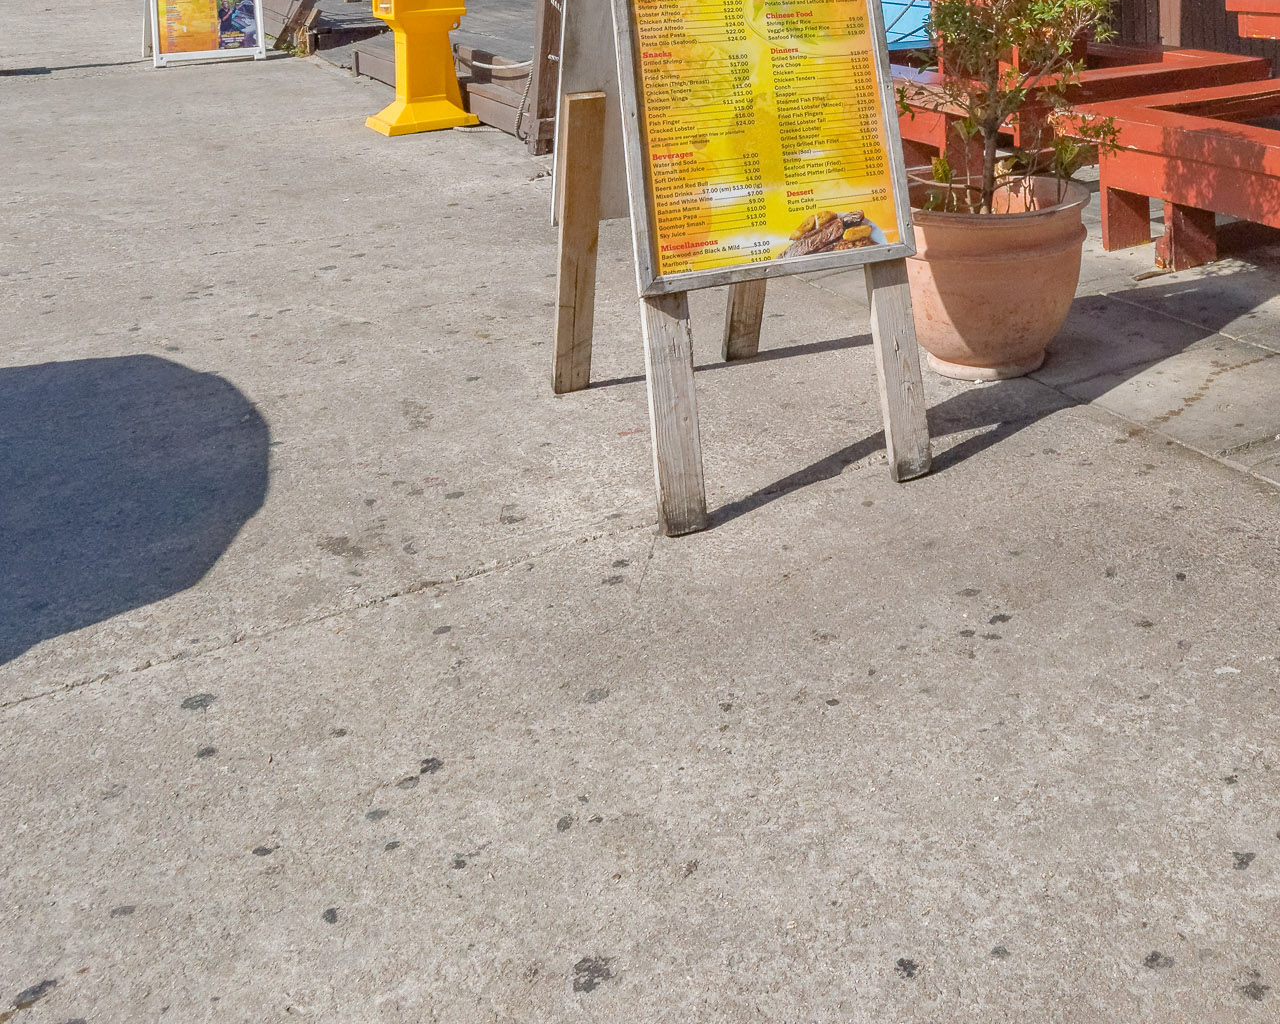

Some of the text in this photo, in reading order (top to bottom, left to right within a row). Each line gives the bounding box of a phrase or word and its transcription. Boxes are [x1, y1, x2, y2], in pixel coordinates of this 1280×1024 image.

[653, 151, 693, 160] Beverages
[787, 189, 814, 197] Dessert
[661, 239, 718, 252] Miscellaneous
[662, 251, 691, 260] Backwood
